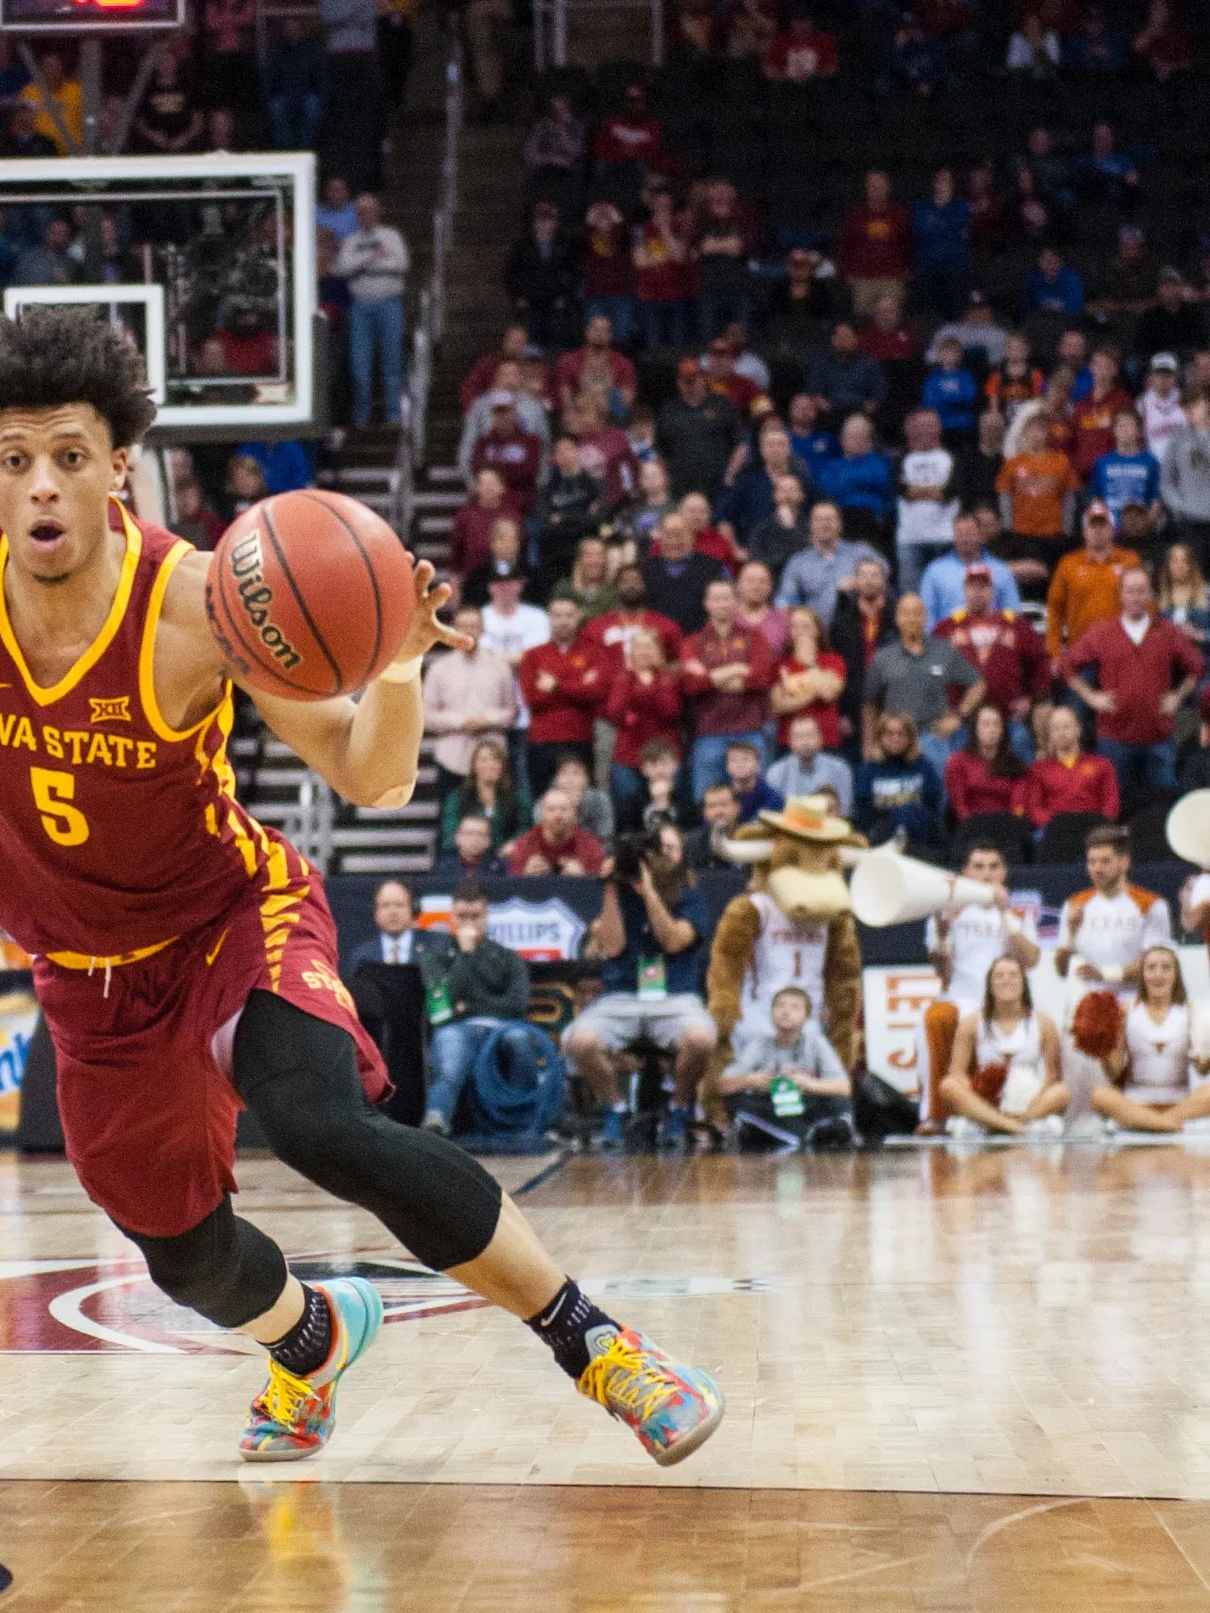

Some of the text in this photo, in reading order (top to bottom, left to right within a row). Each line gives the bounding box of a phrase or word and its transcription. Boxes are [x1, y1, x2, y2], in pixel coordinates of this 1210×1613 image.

[230, 530, 303, 670] Wilson
[42, 725, 157, 769] STATE
[30, 767, 90, 847] 5
